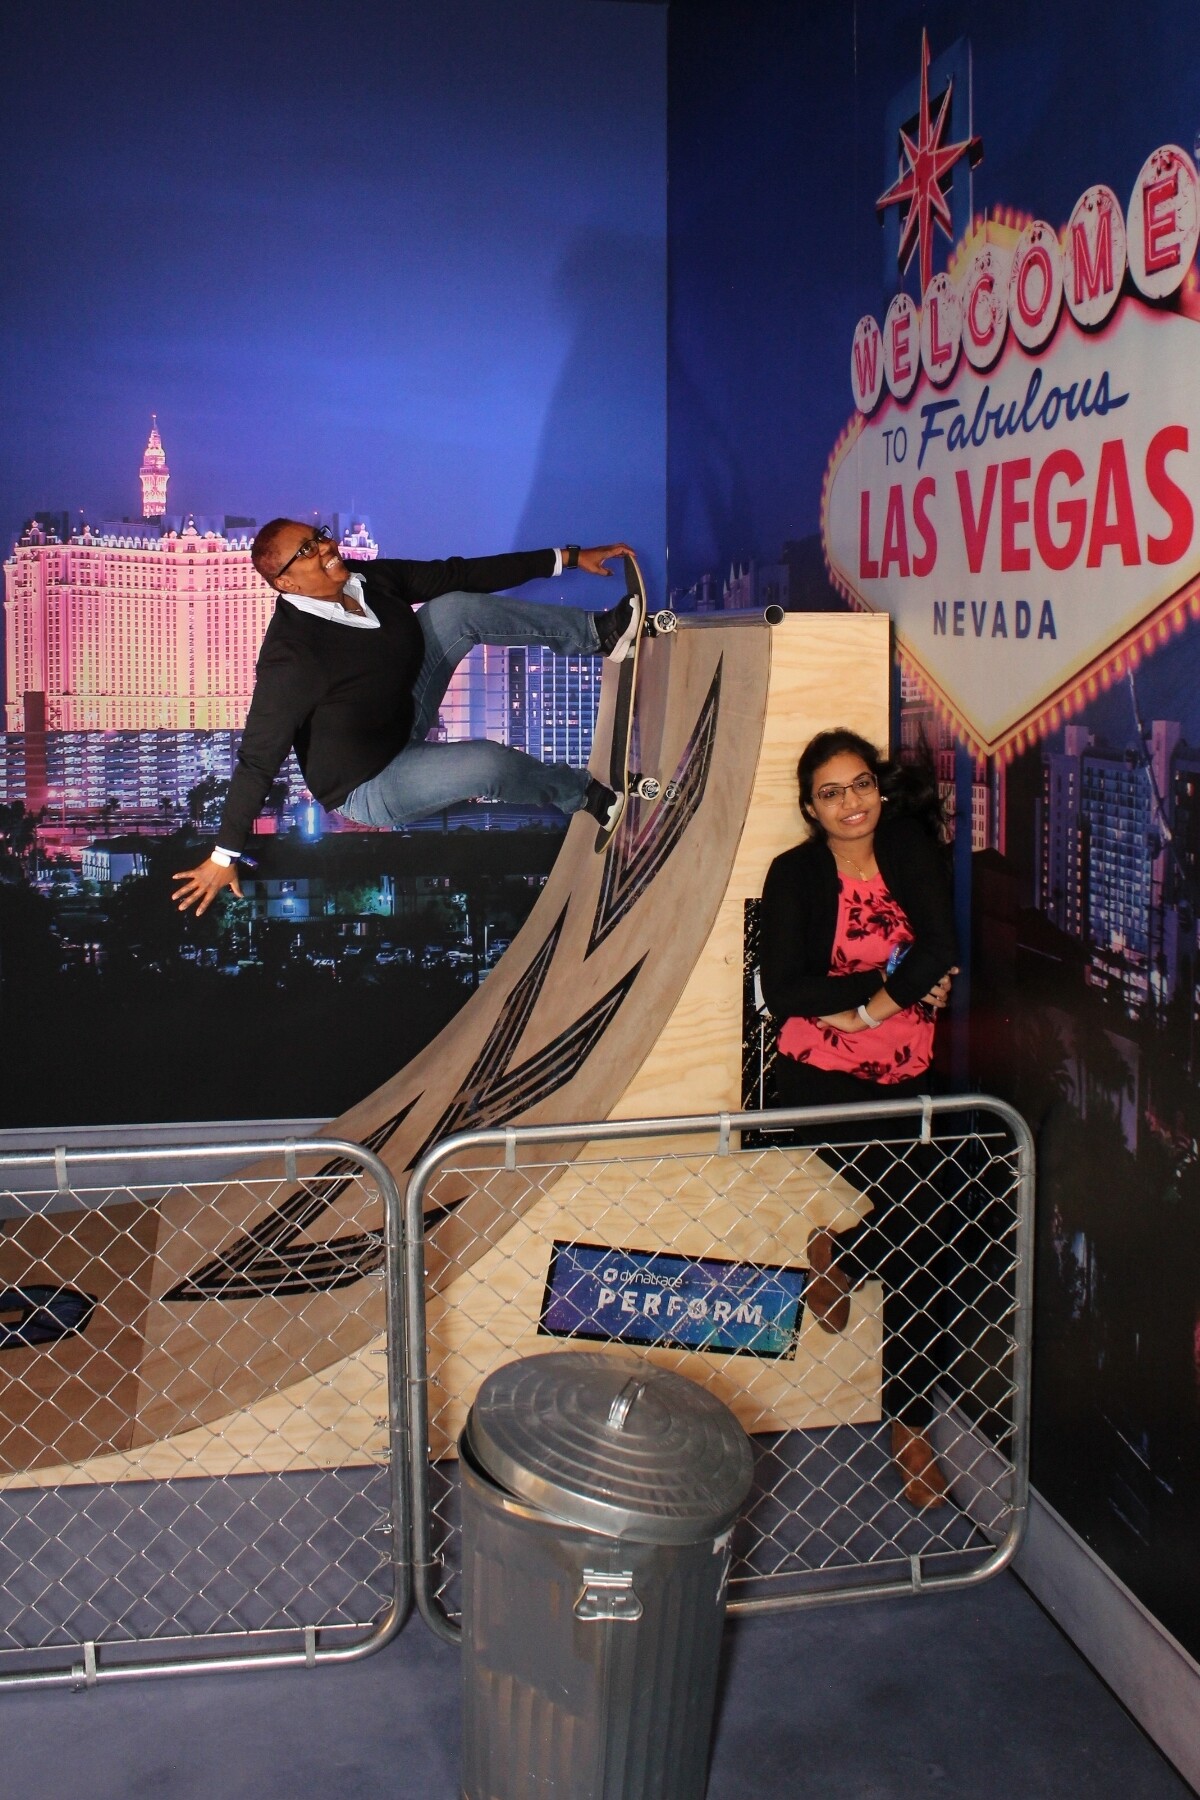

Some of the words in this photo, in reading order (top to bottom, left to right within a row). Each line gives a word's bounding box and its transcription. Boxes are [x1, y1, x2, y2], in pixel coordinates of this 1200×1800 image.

[852, 178, 1182, 400] WELCOME
[882, 427, 908, 466] TO
[916, 367, 1131, 470] Fabulous
[859, 476, 938, 579] LAS
[955, 425, 1194, 574] VEGAS
[933, 600, 1057, 640] NEVADA
[597, 1287, 763, 1327] PERFORM
[619, 1269, 683, 1288] dynatrace
